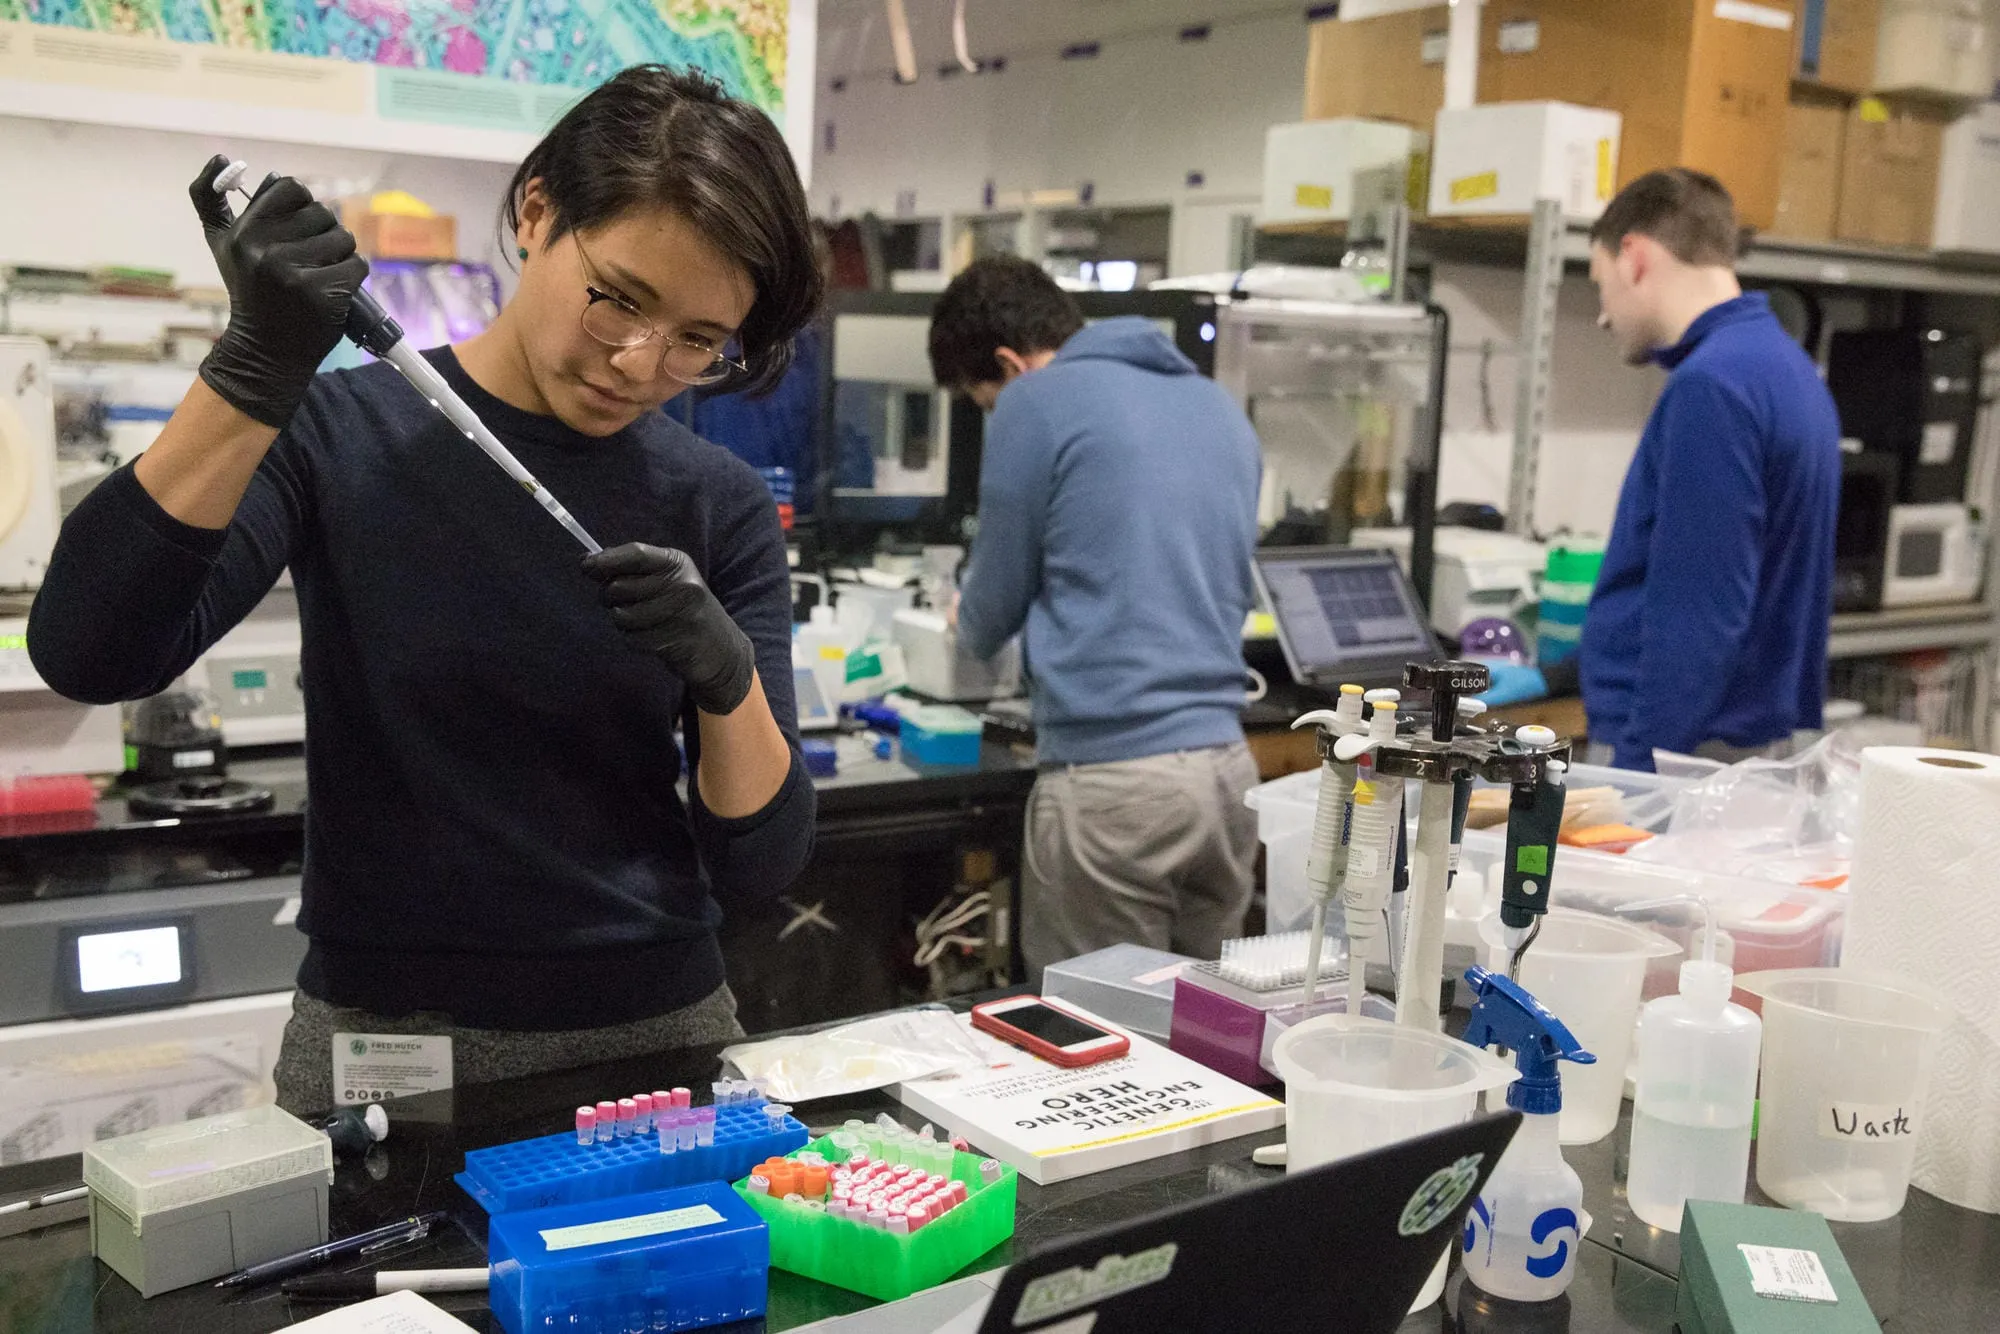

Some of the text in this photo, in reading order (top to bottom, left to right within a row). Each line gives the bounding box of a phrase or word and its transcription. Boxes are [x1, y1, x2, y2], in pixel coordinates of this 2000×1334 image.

[1451, 678, 1486, 689] GILSON
[1416, 762, 1425, 776] 2
[1529, 765, 1537, 779] 3
[395, 1042, 422, 1050] HUTCH
[1042, 1081, 1140, 1109] HERO
[1016, 1081, 1203, 1130] ENGINEERING
[1072, 1097, 1191, 1131] GENETIC
